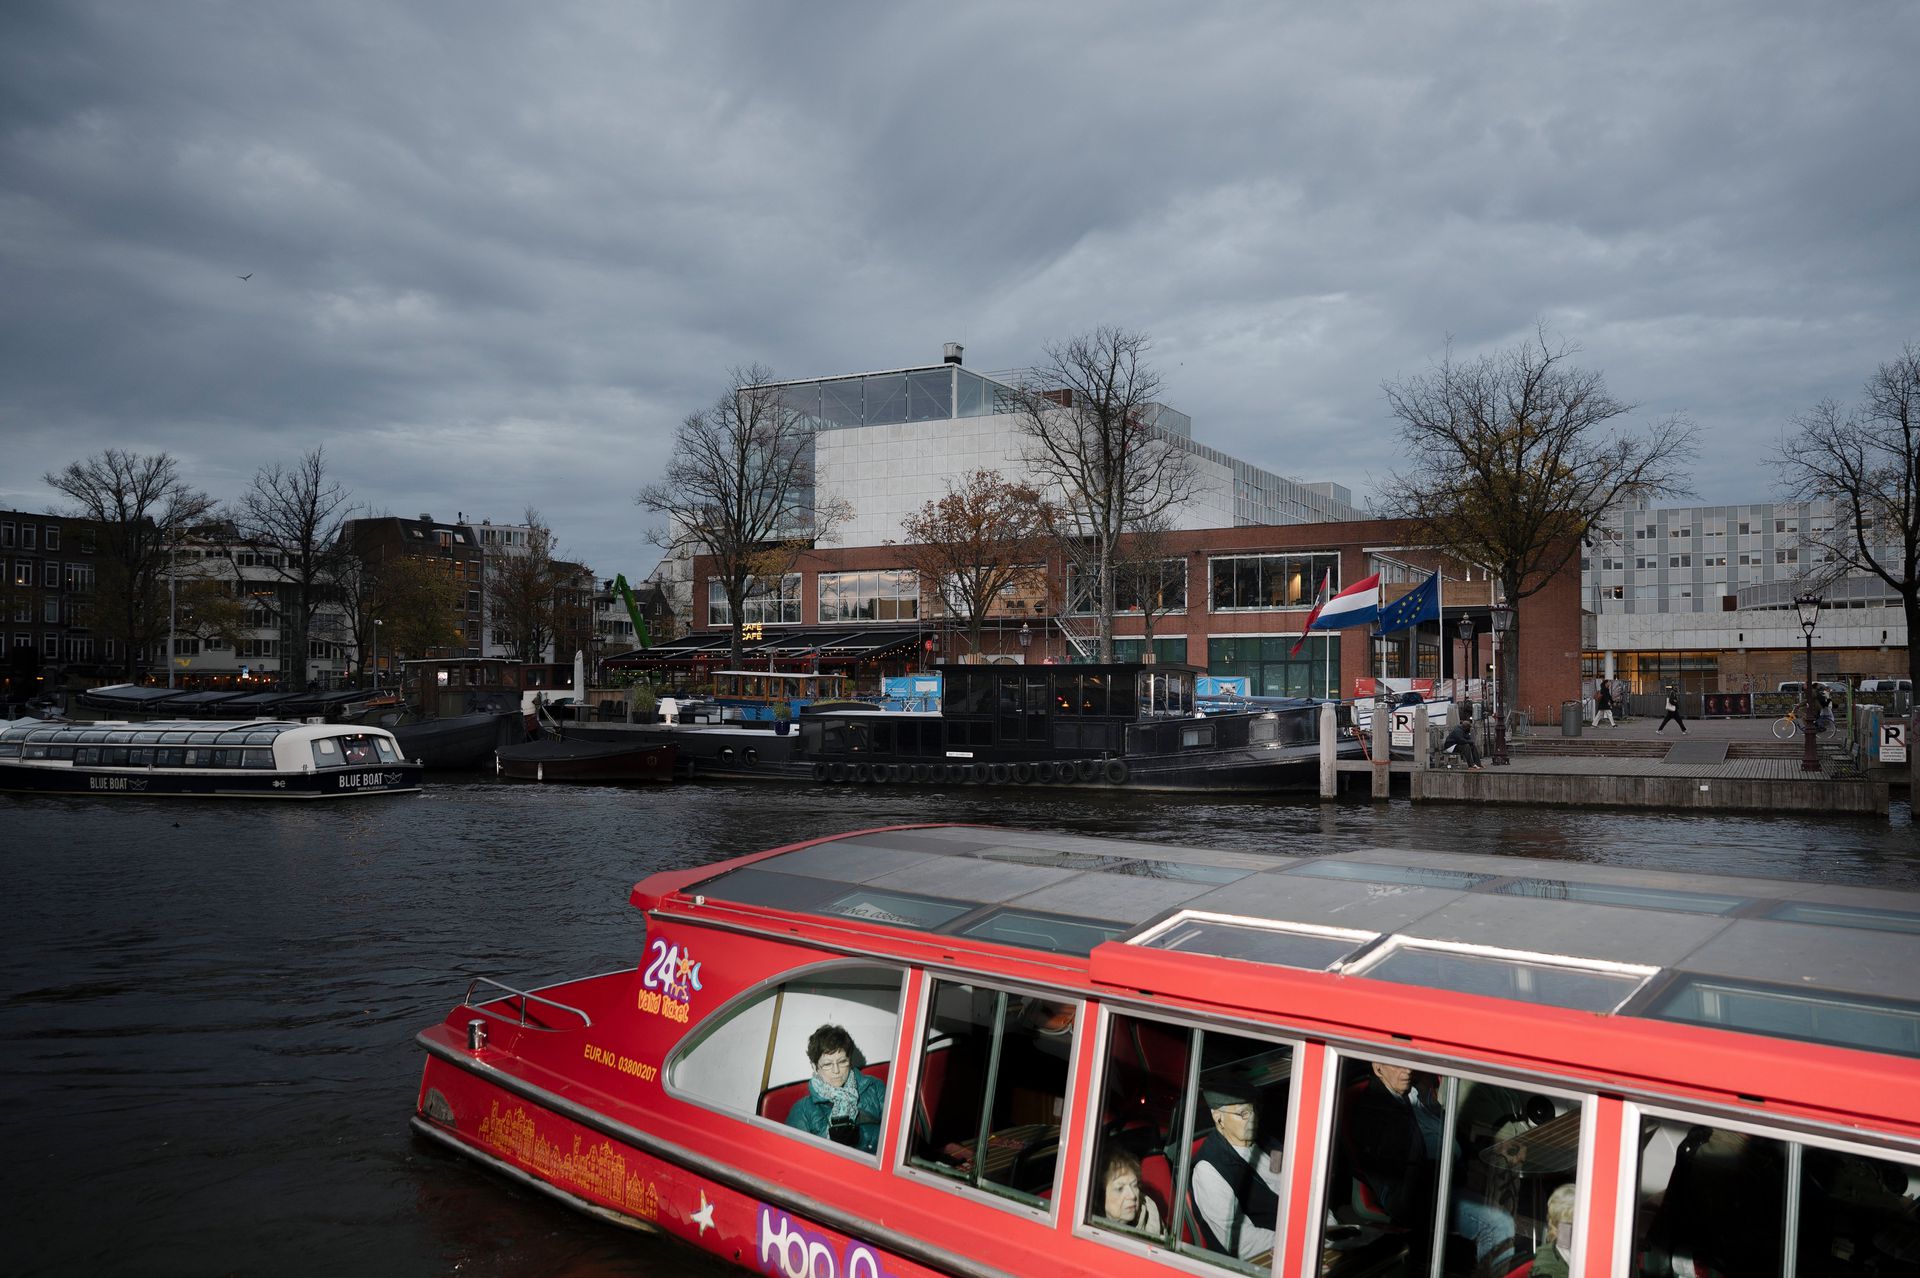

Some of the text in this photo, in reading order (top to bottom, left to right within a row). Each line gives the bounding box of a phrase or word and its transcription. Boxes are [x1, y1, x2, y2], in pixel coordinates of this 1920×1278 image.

[1396, 714, 1408, 730] P
[1884, 726, 1900, 744] P
[90, 776, 127, 790] BLUE BOAT
[340, 772, 383, 787] BLUE BOAT
[644, 940, 678, 992] 24
[638, 988, 690, 1024] Valid Ticket
[584, 1044, 657, 1082] EUR.NO. 03800207
